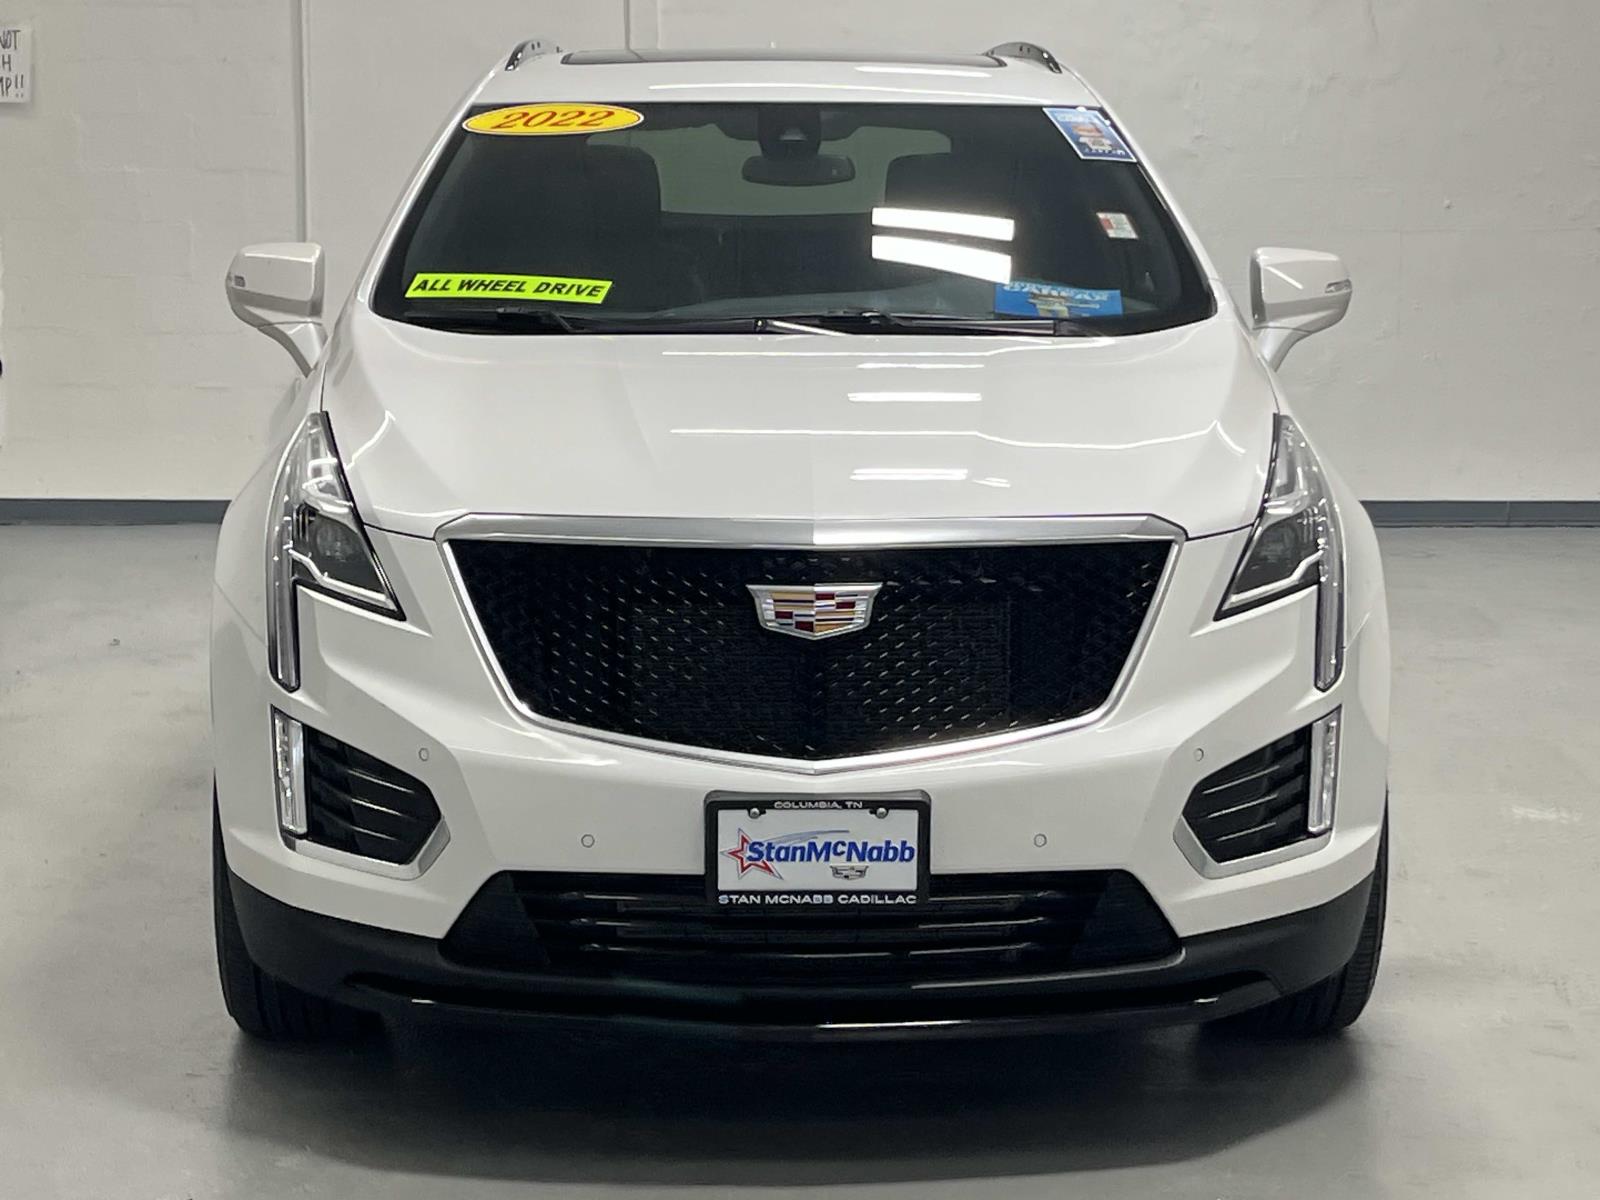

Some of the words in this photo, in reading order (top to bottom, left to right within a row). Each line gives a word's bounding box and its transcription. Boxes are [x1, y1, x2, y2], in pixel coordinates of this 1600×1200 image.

[490, 110, 616, 130] 2022
[412, 278, 453, 292] ALL
[456, 279, 528, 293] WHEEL
[532, 281, 605, 298] DRIVE
[773, 800, 843, 810] COLUMBIA,
[845, 800, 863, 809] TN
[718, 893, 761, 905] STAN
[765, 893, 835, 905] MCNABB
[837, 893, 918, 905] CADILLAC
